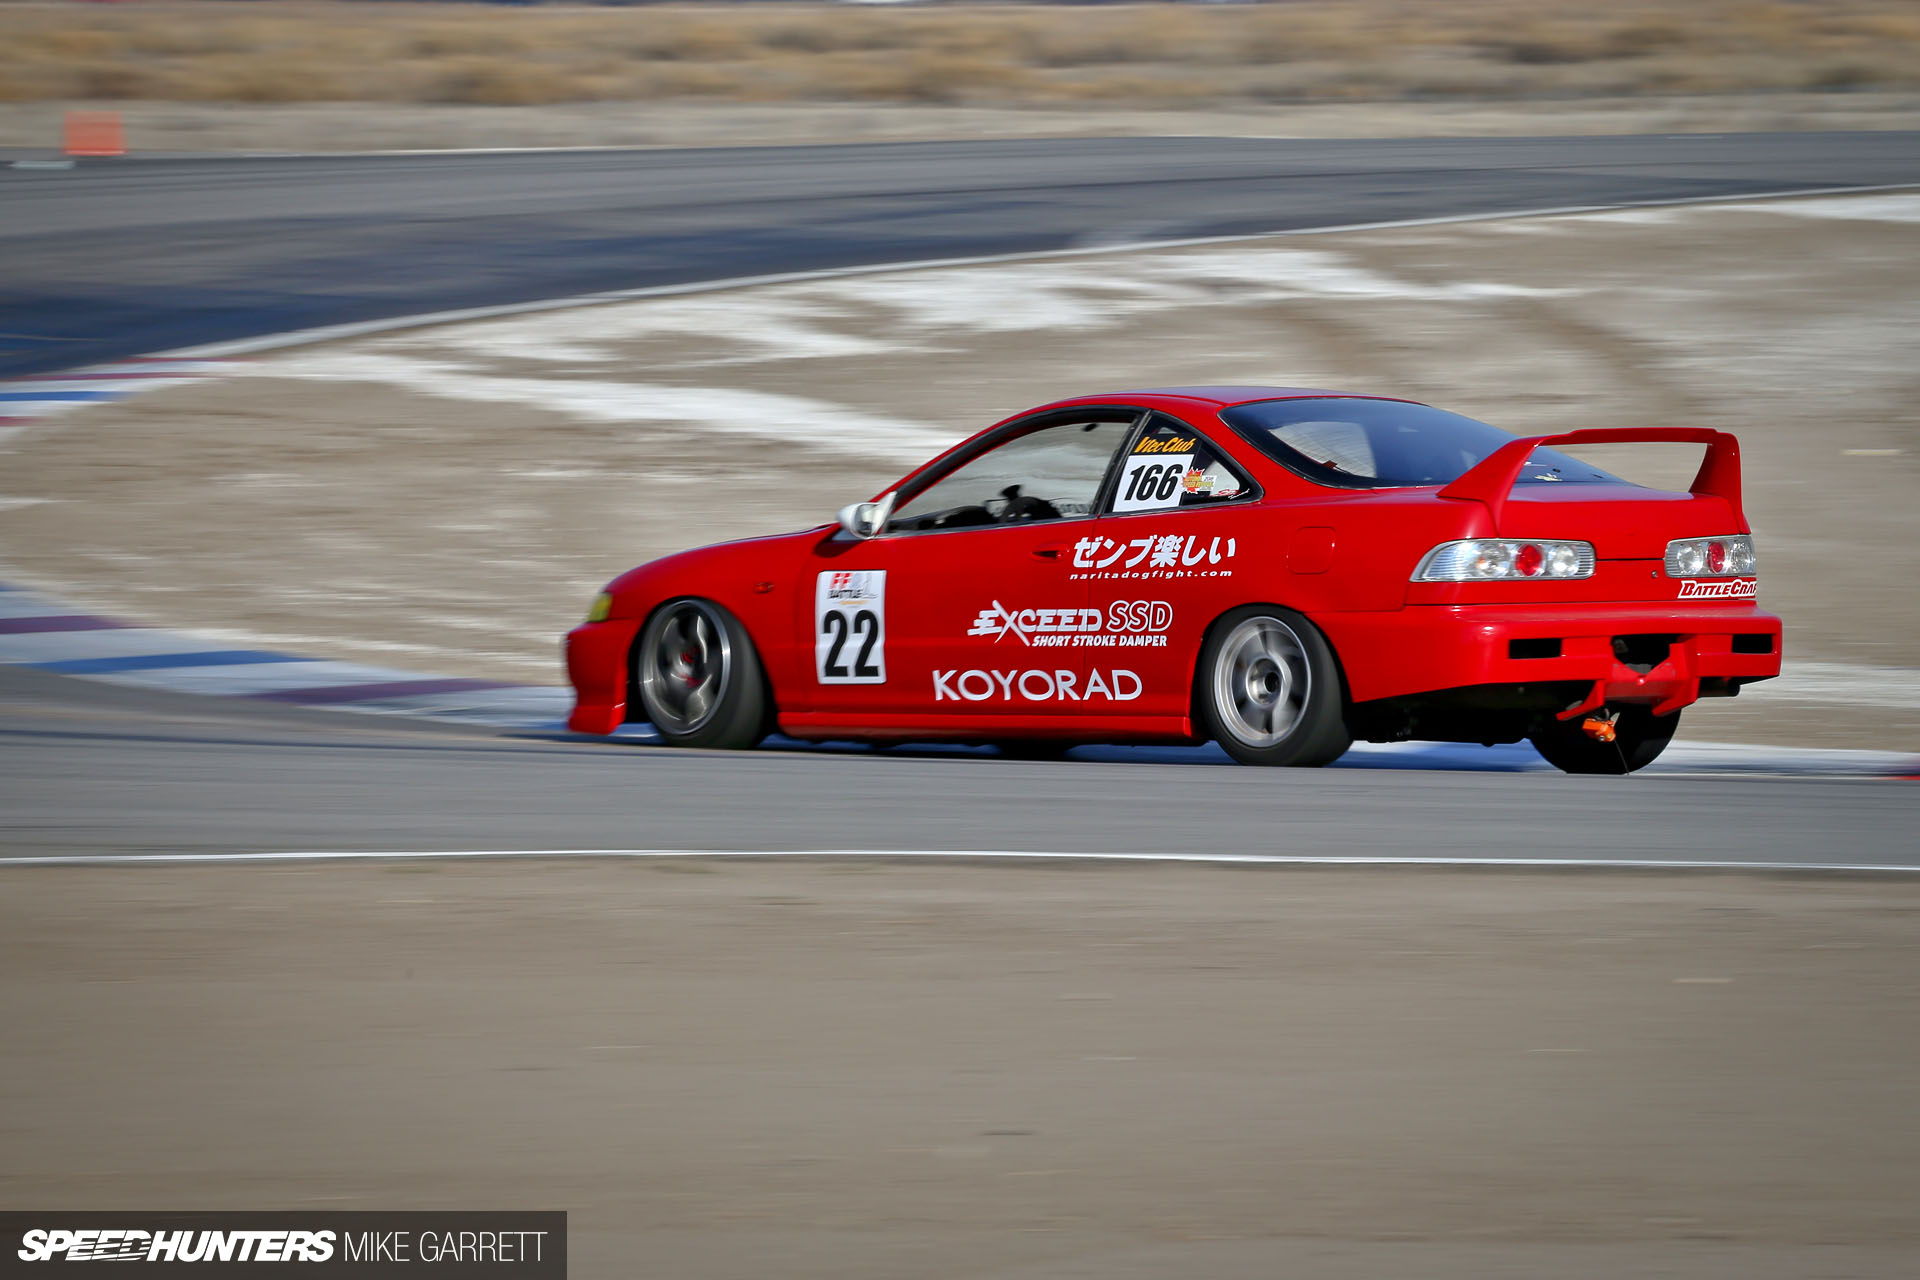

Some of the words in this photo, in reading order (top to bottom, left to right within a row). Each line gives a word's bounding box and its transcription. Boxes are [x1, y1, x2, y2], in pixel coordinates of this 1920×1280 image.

[1162, 436, 1197, 453] Club
[1124, 463, 1184, 501] 166
[1072, 534, 1236, 569] ゼンブ楽しい
[1070, 569, 1232, 580] naritadogfight.com
[967, 599, 1103, 647] EXCEED
[1106, 600, 1173, 633] SSD
[822, 609, 879, 678] 22
[1032, 635, 1071, 647] SHORT
[1072, 635, 1117, 647] STROKE
[1118, 635, 1168, 647] DAMPER
[932, 667, 1143, 701] KOYORAD
